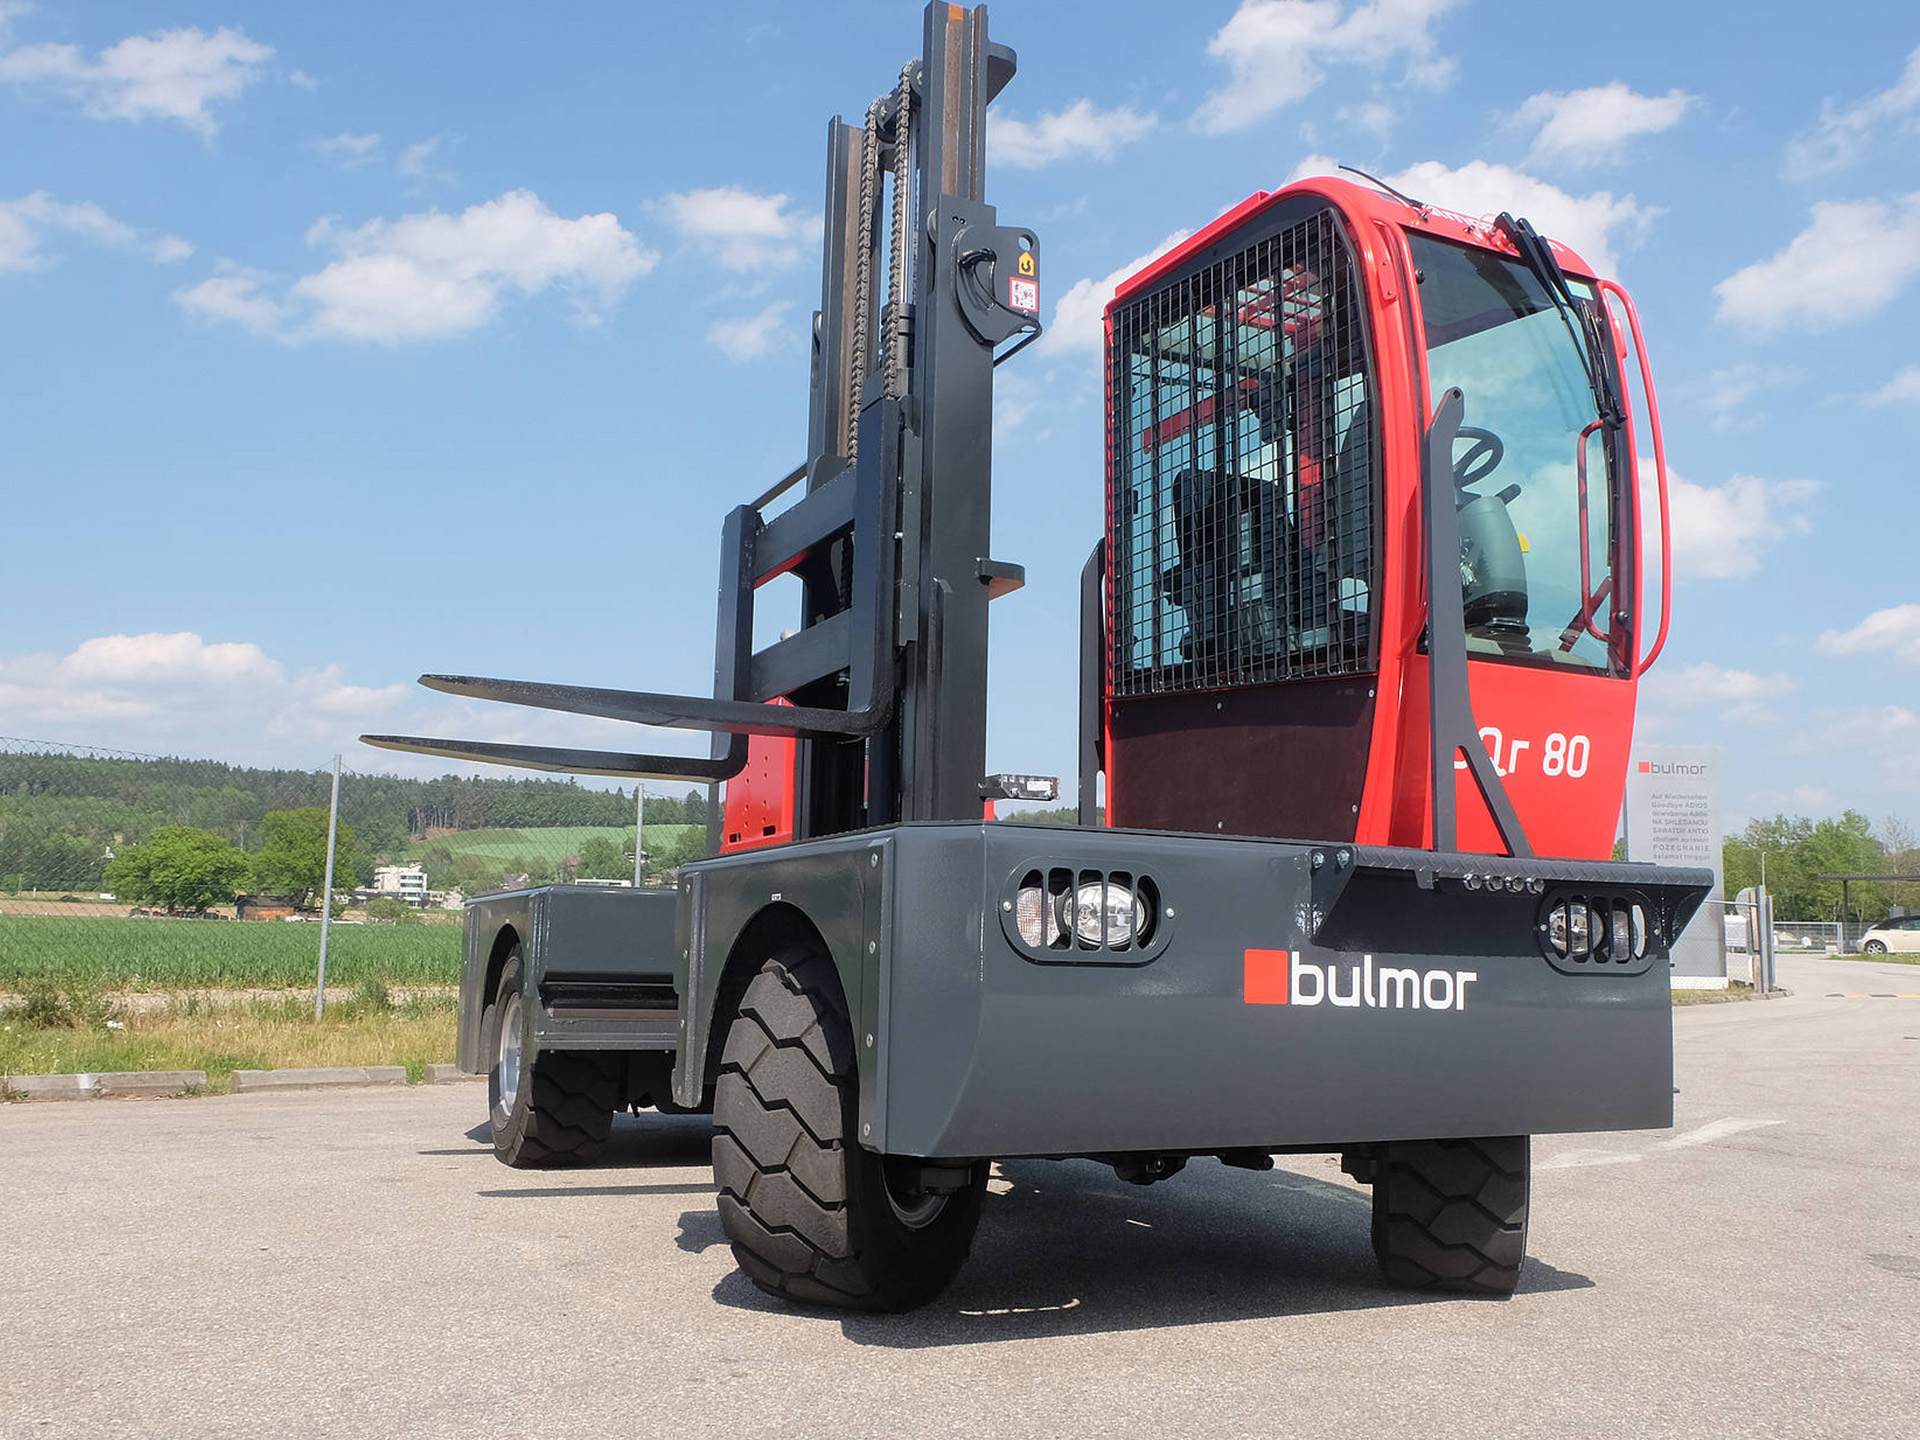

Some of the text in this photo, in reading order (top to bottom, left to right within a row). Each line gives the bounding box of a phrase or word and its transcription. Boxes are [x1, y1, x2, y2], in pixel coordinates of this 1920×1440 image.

[1543, 733, 1590, 778] 80
[1651, 762, 1706, 774] bulmor
[1292, 951, 1478, 1011] bulmor
